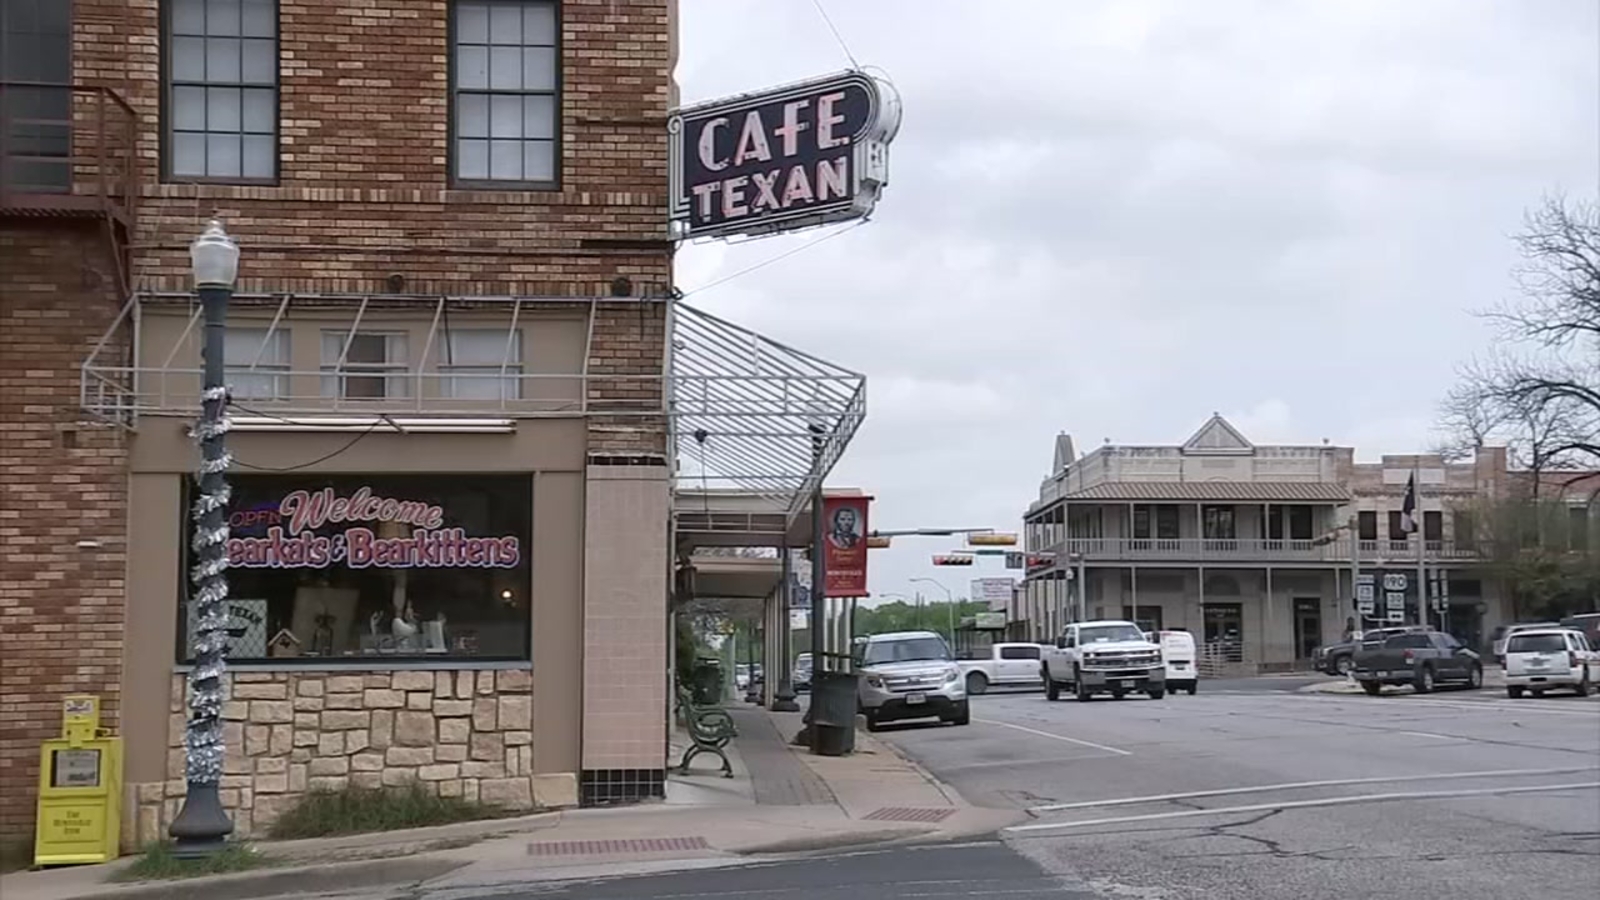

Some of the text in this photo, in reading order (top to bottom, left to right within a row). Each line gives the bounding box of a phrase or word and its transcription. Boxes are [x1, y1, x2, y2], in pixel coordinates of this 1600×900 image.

[698, 91, 850, 172] CAFE
[691, 156, 847, 223] TEXAN
[229, 509, 281, 527] OPEN
[279, 487, 444, 536] Welcome
[226, 526, 520, 569] earkats & Bearkittens
